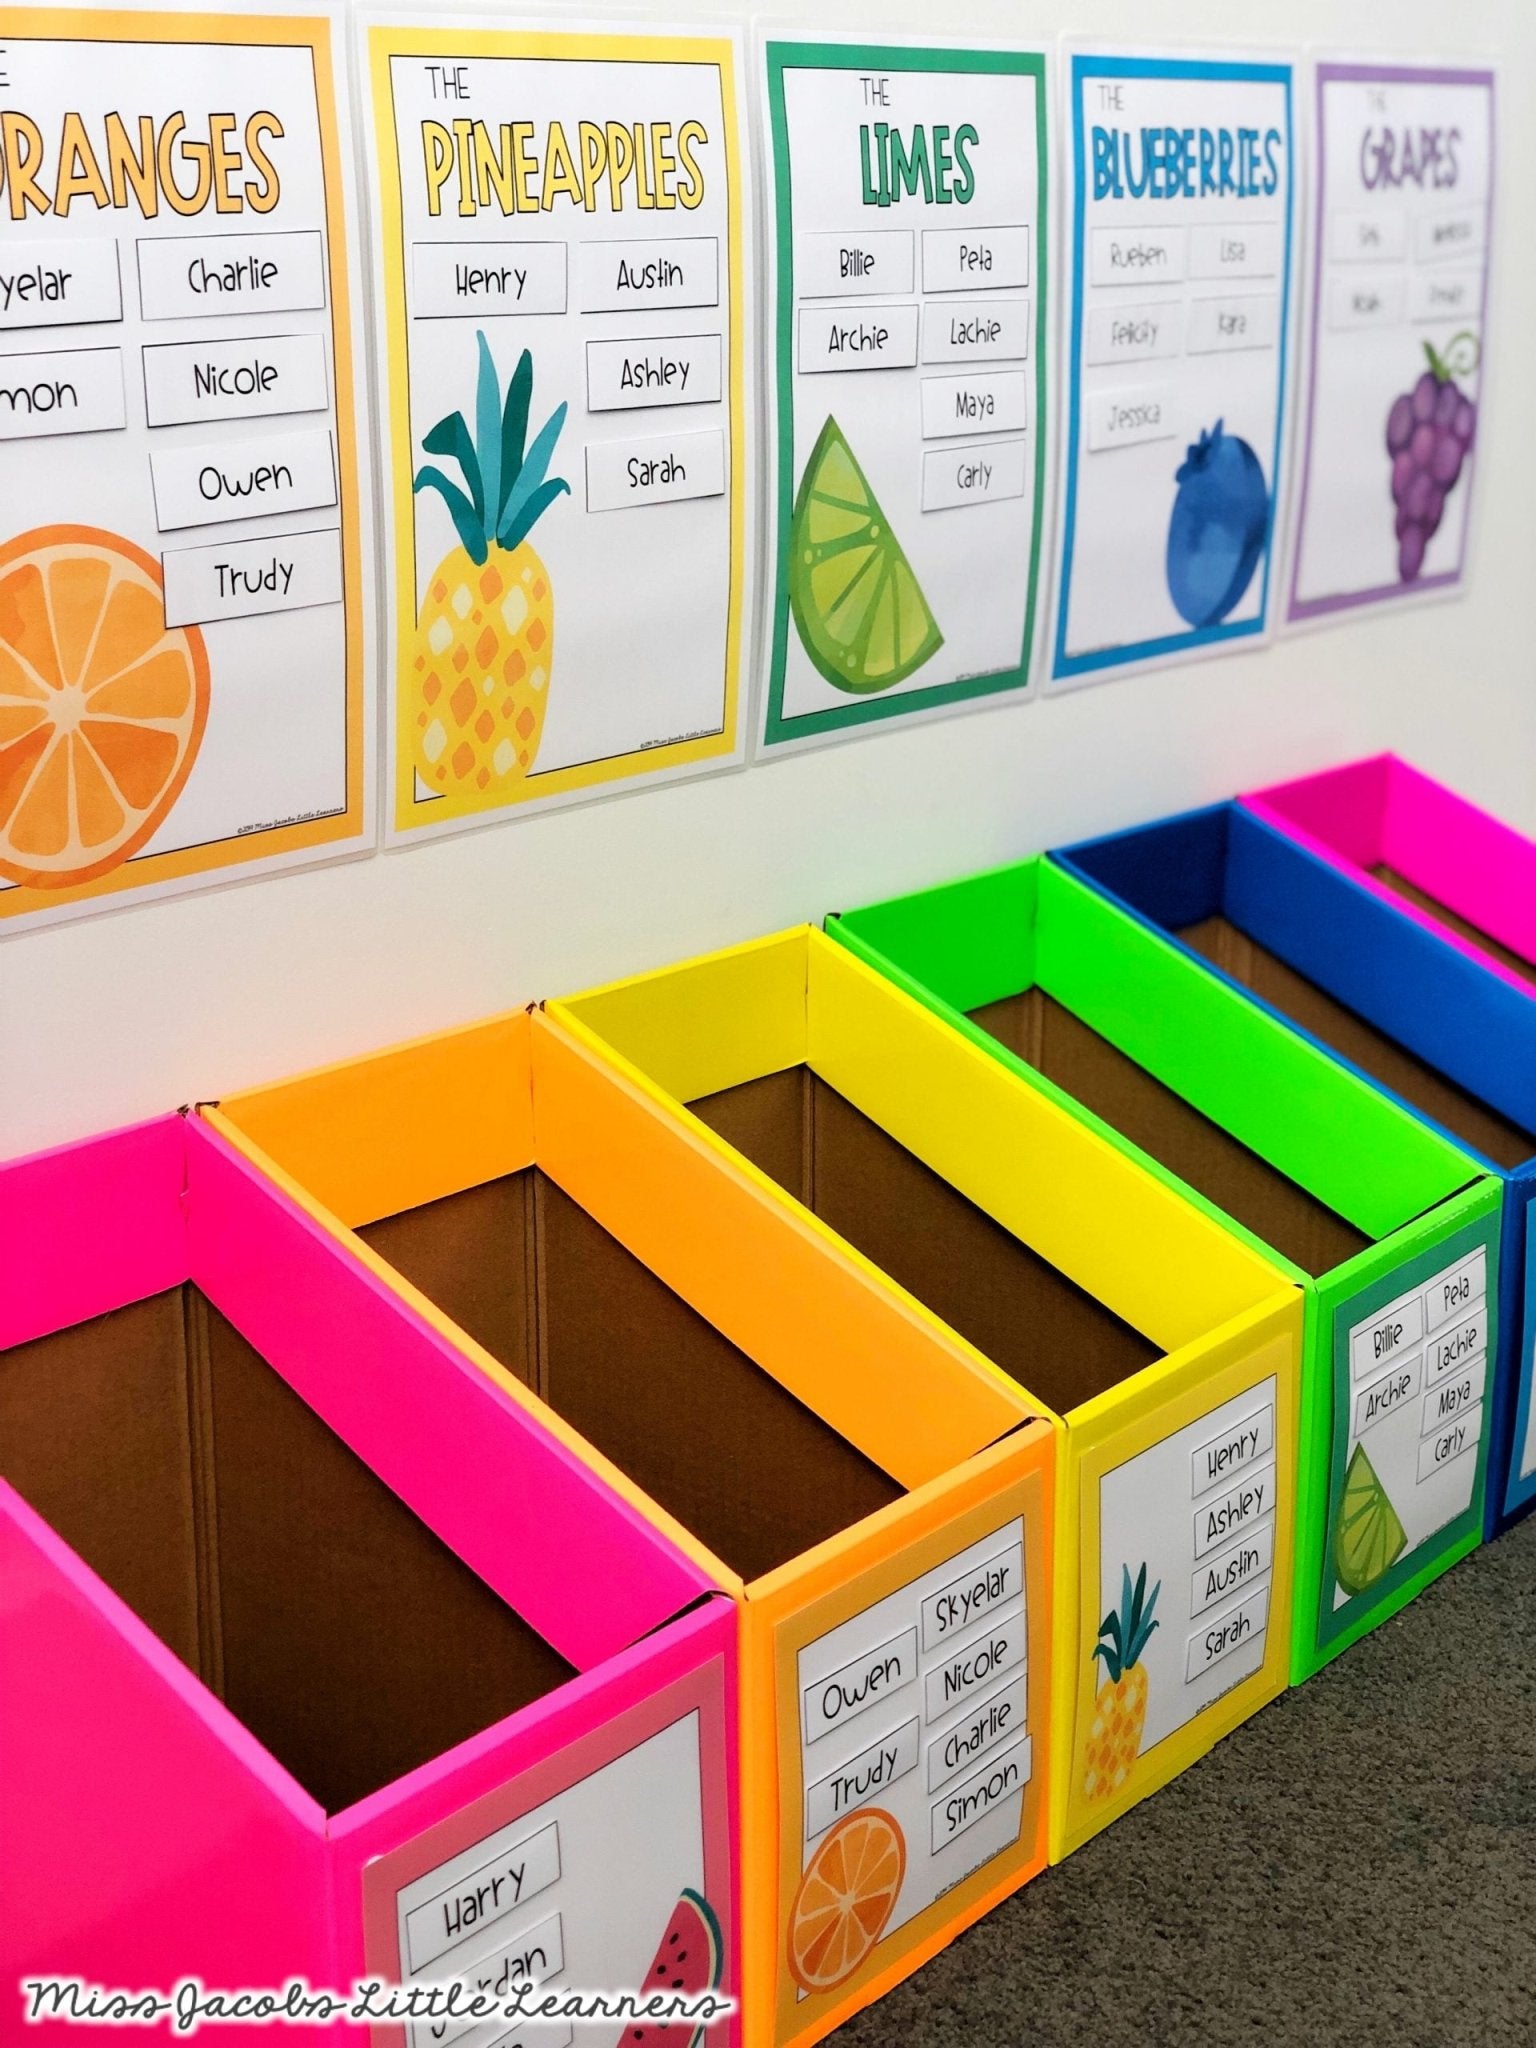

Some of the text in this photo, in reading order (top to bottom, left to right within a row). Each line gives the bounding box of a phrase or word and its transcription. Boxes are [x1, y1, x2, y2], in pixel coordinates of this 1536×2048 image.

[424, 66, 471, 100] THE
[859, 77, 890, 107] THE
[1097, 84, 1124, 112] THE
[0, 110, 285, 220] RANGES
[421, 119, 708, 217] PINEAPPLES
[859, 122, 979, 207] LIMES
[1091, 125, 1282, 201] BLUEBERRIES
[1360, 125, 1463, 190] GRAPES
[188, 256, 279, 294] Charlie
[617, 259, 684, 291] Austin
[839, 248, 875, 278] Billie
[959, 244, 993, 272] Peta
[456, 263, 527, 300] Henry
[828, 324, 889, 353] Archie
[950, 316, 1001, 345] Lachie
[194, 359, 278, 399] Nicole
[620, 358, 690, 390] Ashley
[956, 391, 994, 420] Maya
[199, 464, 293, 500] Owen
[627, 453, 686, 488] Sarah
[957, 462, 992, 490] Carly
[214, 557, 294, 598] Trudy
[1443, 1277, 1470, 1312] Peta
[1373, 1323, 1403, 1359] Billie
[1438, 1328, 1477, 1371] Lachie
[1365, 1374, 1411, 1422] Archie
[1438, 1380, 1471, 1418] Maya
[1207, 1428, 1259, 1478] Henry
[1434, 1425, 1466, 1462] Carly
[1206, 1485, 1264, 1542] Ashley
[1205, 1548, 1259, 1600] Austin
[936, 1566, 1009, 1632] Skyelar
[1206, 1612, 1250, 1660] Sarah
[822, 1656, 900, 1719] Owen
[944, 1639, 1008, 1700] Nicole
[944, 1703, 1011, 1768] Charlie
[831, 1747, 898, 1811] Trudy
[946, 1762, 1018, 1832] Simon
[443, 1862, 525, 1938] Harry
